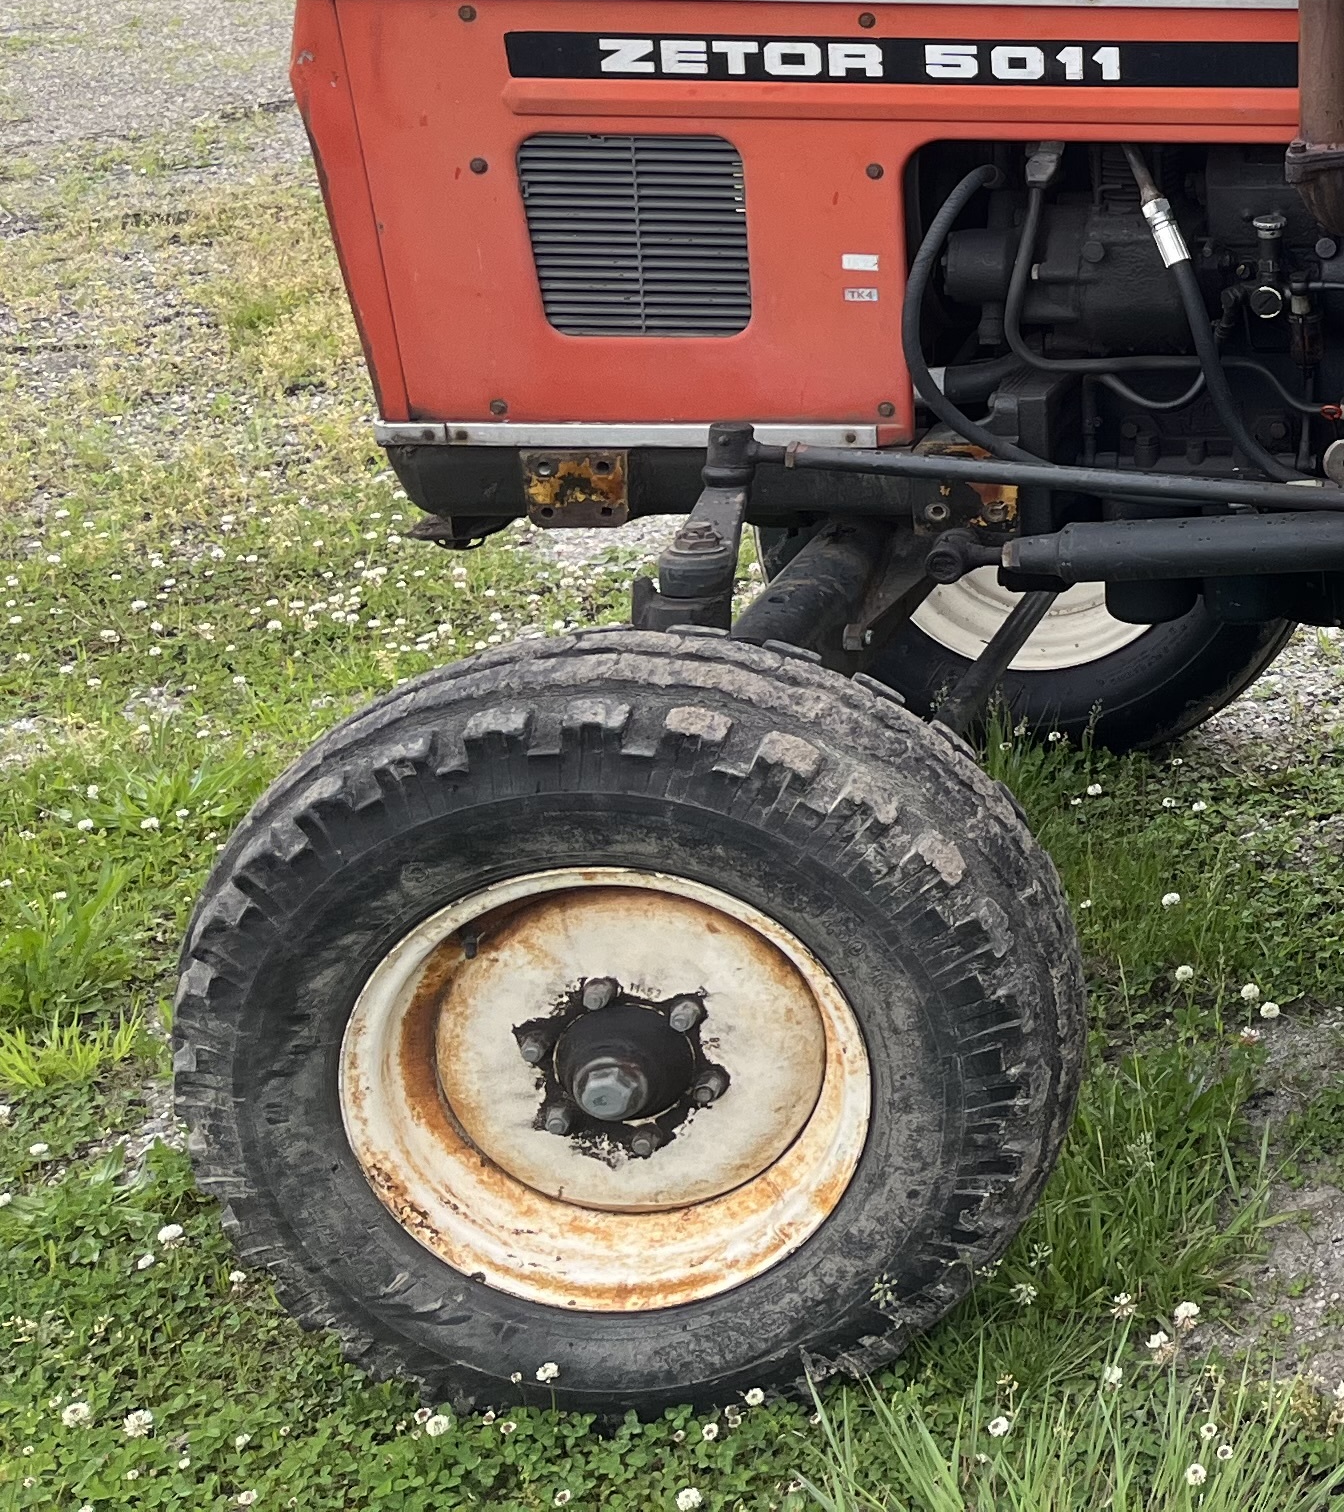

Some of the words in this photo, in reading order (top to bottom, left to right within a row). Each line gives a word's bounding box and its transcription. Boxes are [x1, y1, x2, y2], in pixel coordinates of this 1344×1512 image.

[599, 38, 884, 78] ZETOR
[925, 44, 1122, 81] 5011
[847, 290, 874, 300] TK4
